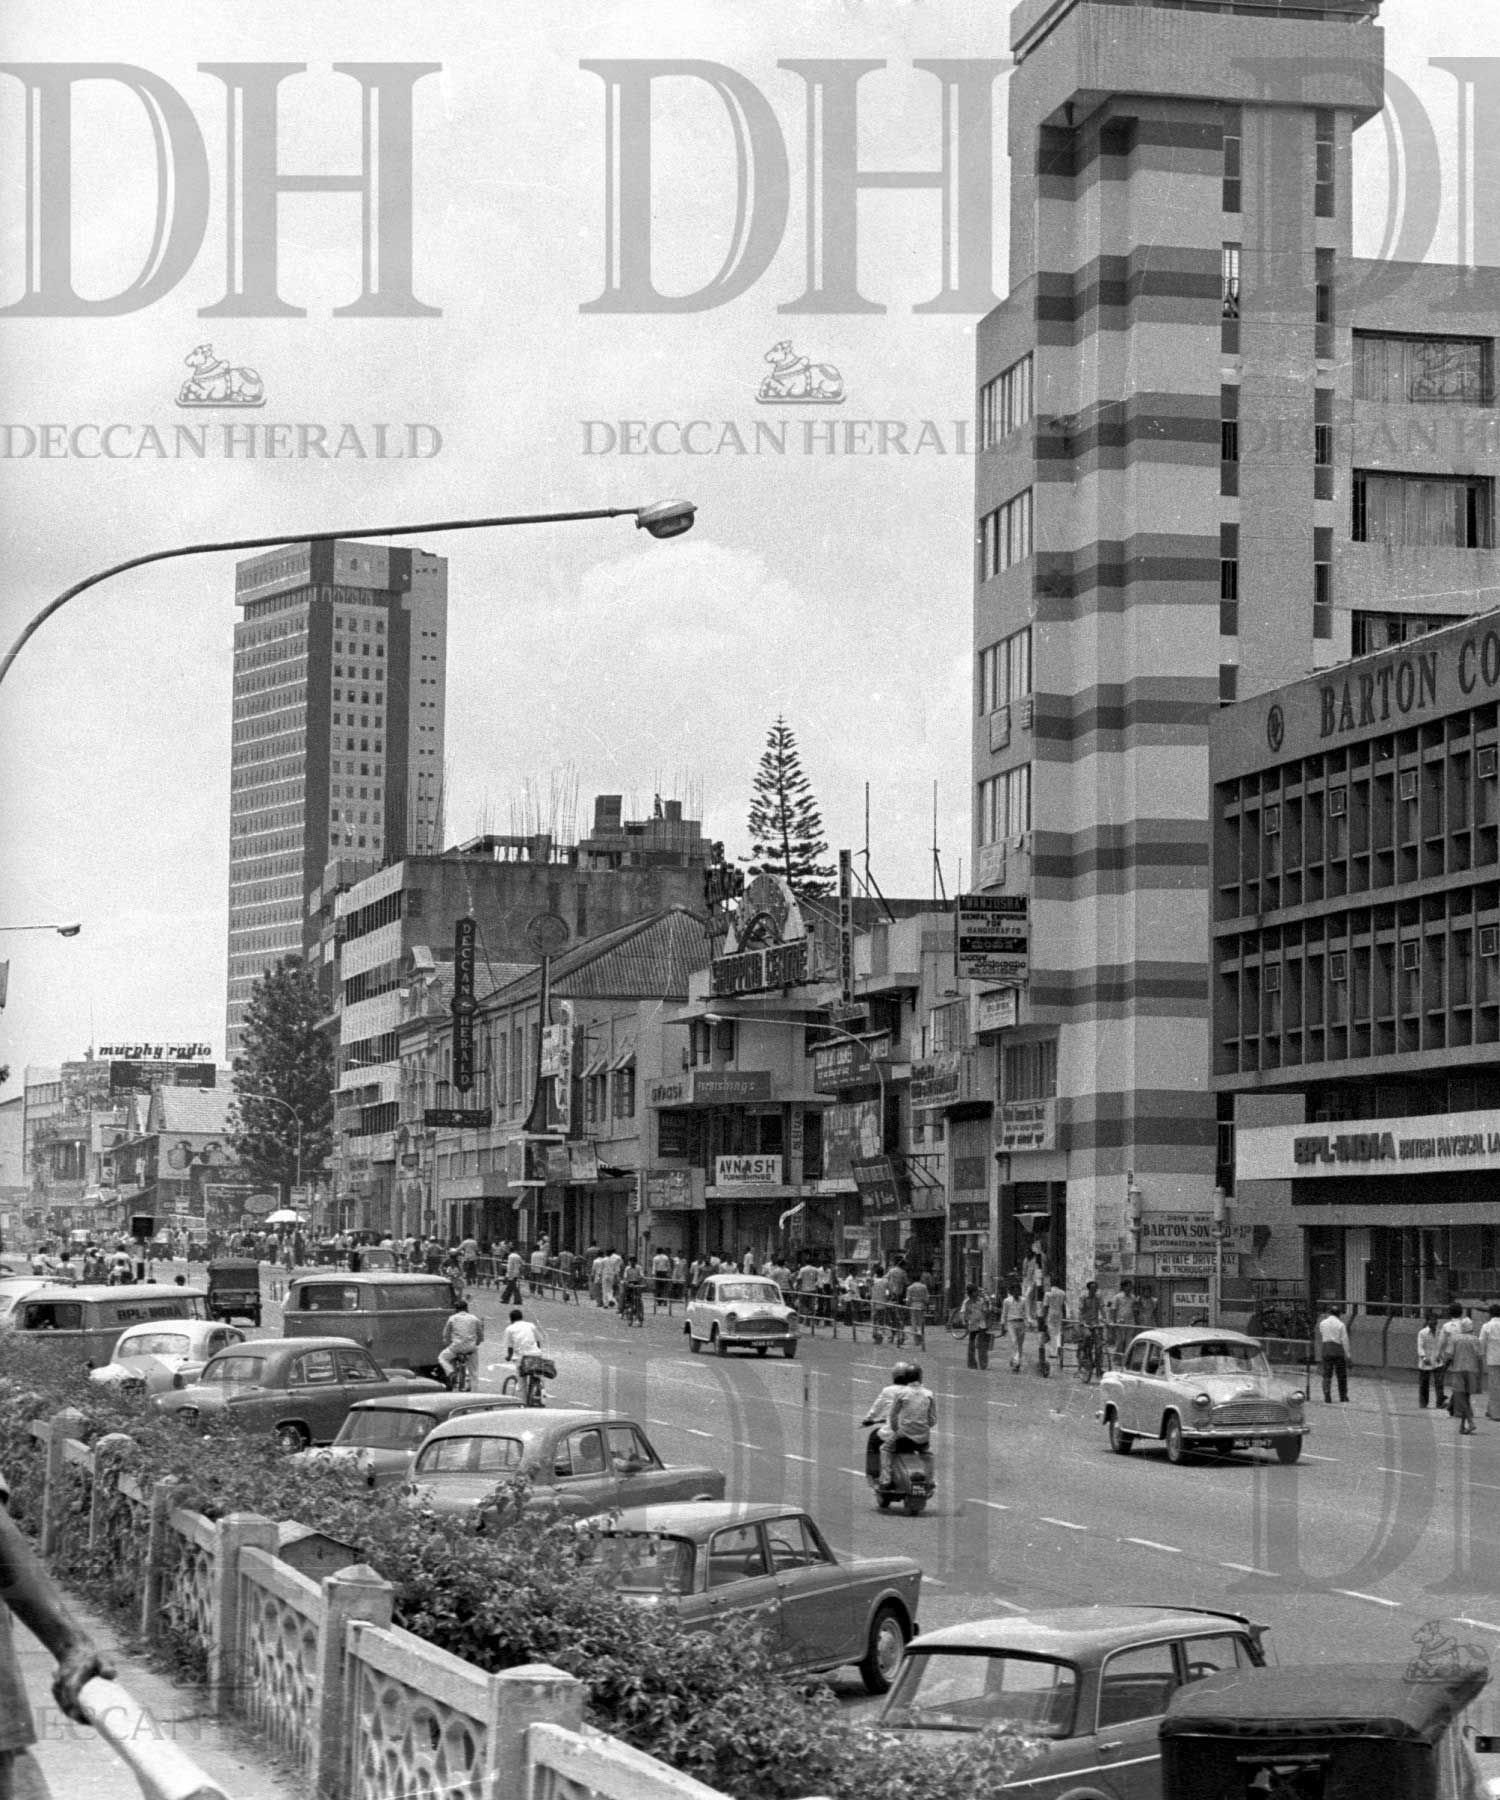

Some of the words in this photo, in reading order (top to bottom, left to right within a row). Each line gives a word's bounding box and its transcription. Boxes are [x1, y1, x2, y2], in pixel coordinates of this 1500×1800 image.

[1319, 650, 1440, 739] BARTON
[461, 923, 473, 993] DECCAN
[100, 1043, 163, 1059] murphy
[169, 1043, 212, 1057] radio
[460, 1016, 470, 1084] HERALD
[1294, 1132, 1396, 1164] BPL-INDIA
[1437, 1133, 1486, 1157] PHYSICAL
[719, 1159, 776, 1174] AVNASH
[1143, 1223, 1186, 1238] BARTON
[1189, 1224, 1210, 1238] SON
[1157, 1254, 1190, 1265] PRIVATE
[1192, 1254, 1217, 1265] DRIVE
[117, 1304, 182, 1320] BPL-INDIA
